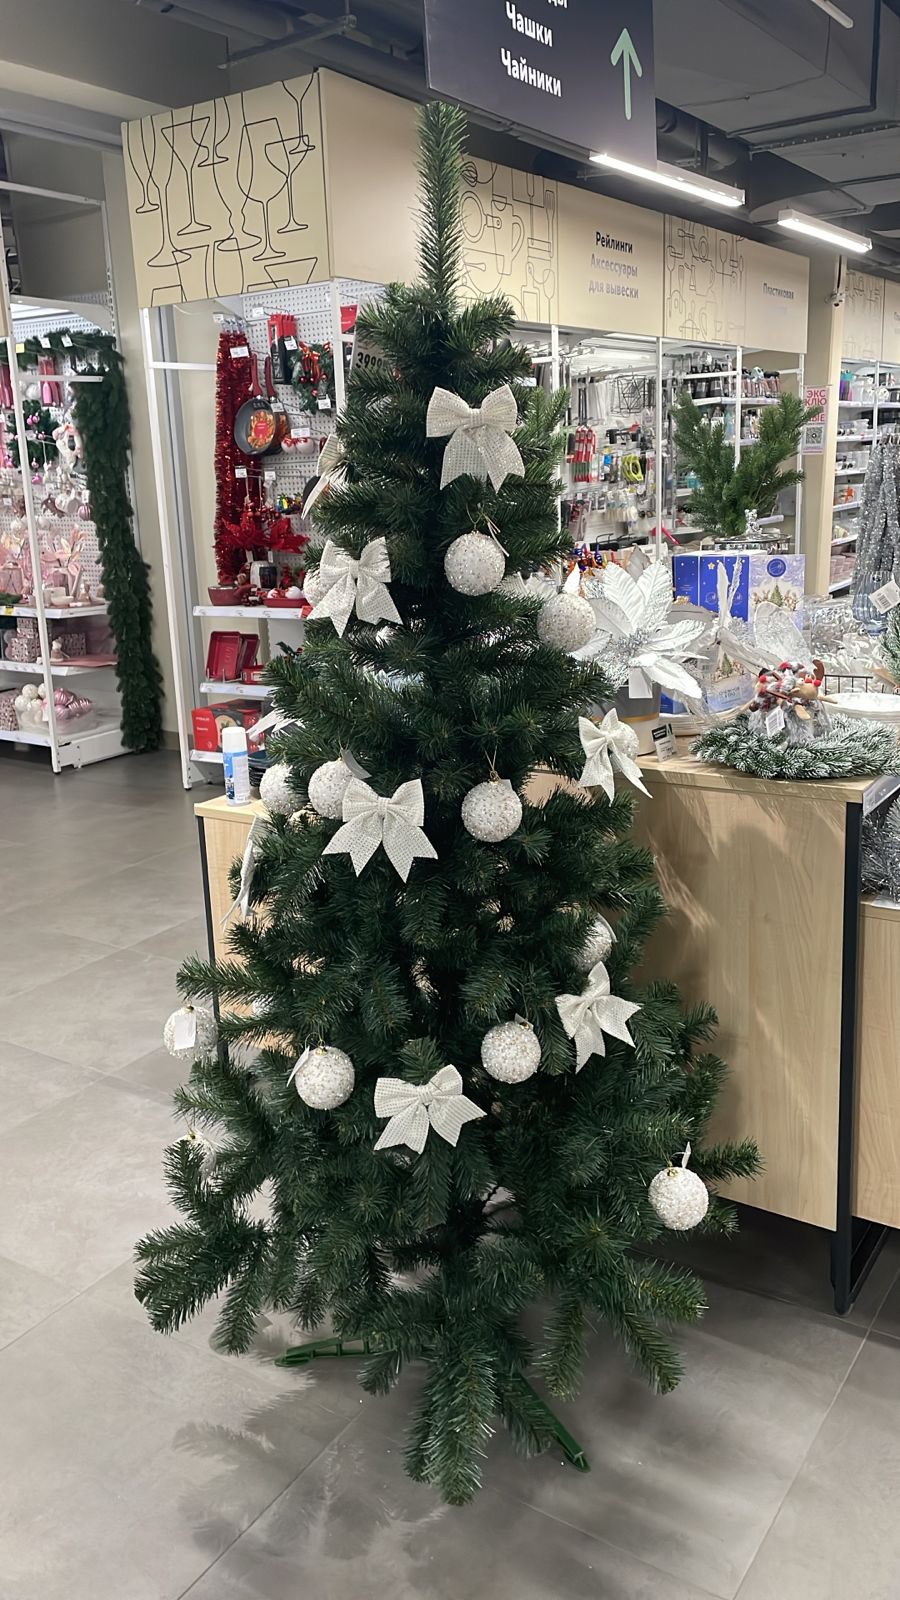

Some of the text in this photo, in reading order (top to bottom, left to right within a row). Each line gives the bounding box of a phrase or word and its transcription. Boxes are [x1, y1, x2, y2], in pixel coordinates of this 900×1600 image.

[506, 1, 553, 47] Чашки
[501, 48, 562, 97] Чайники
[595, 231, 633, 254] Рейлинги
[591, 253, 638, 279] Аксессуары
[589, 280, 604, 295] для
[805, 397, 827, 406] КЛЮ
[806, 389, 826, 398] ЭКС
